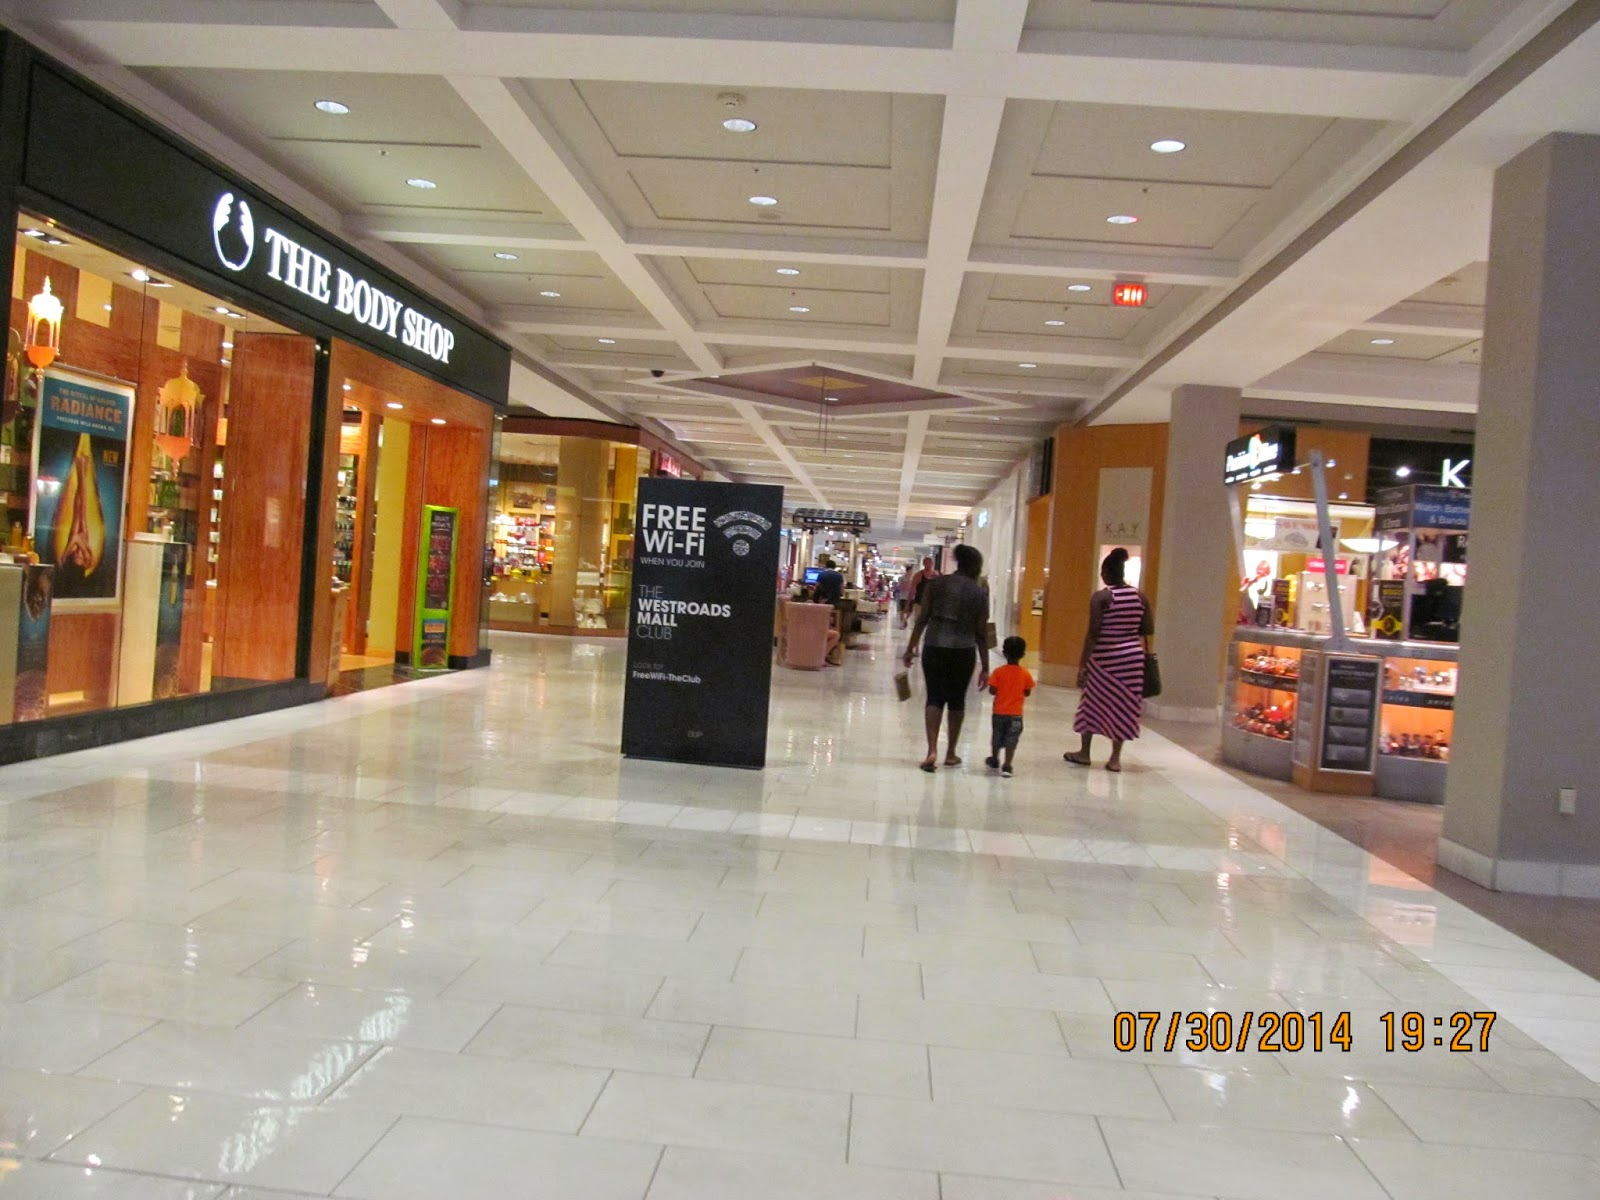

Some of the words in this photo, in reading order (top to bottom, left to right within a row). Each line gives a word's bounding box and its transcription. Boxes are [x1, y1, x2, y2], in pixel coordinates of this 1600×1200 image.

[264, 227, 332, 305] THE
[334, 267, 404, 339] BODY
[402, 306, 455, 364] SHOP
[50, 395, 123, 424] RADIANCE
[642, 503, 706, 532] FREE
[642, 529, 705, 557] Wi-Fi
[640, 556, 665, 566] WHEN
[666, 558, 684, 567] YOU
[685, 560, 705, 569] JOIN
[639, 584, 663, 600] THE
[638, 598, 732, 618] WESTROADS
[637, 612, 678, 627] MALL
[636, 625, 673, 640] CLUB
[632, 670, 702, 685] FreeWiFi-TheClub
